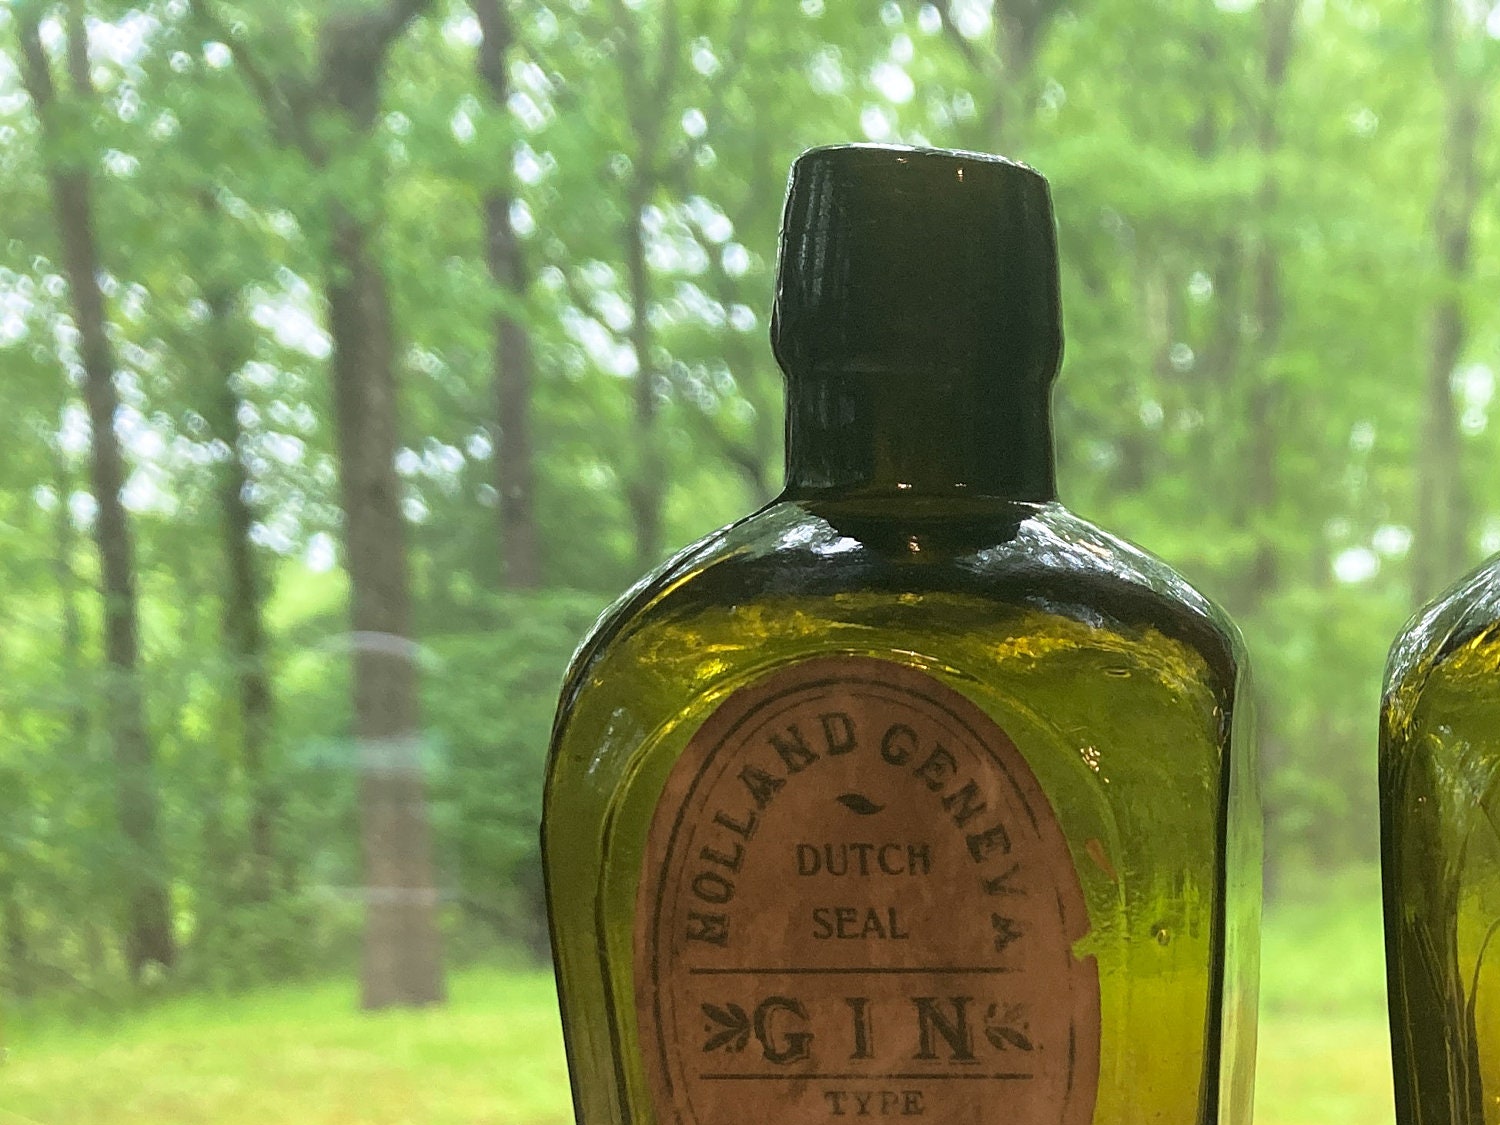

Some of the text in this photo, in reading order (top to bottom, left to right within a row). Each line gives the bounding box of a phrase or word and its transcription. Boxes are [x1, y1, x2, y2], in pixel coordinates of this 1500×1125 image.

[880, 722, 1027, 952] GENEVA
[796, 842, 931, 877] DUTCH
[812, 906, 909, 940] SEAL
[753, 996, 980, 1065] GIN
[824, 1090, 926, 1116] TYPE
